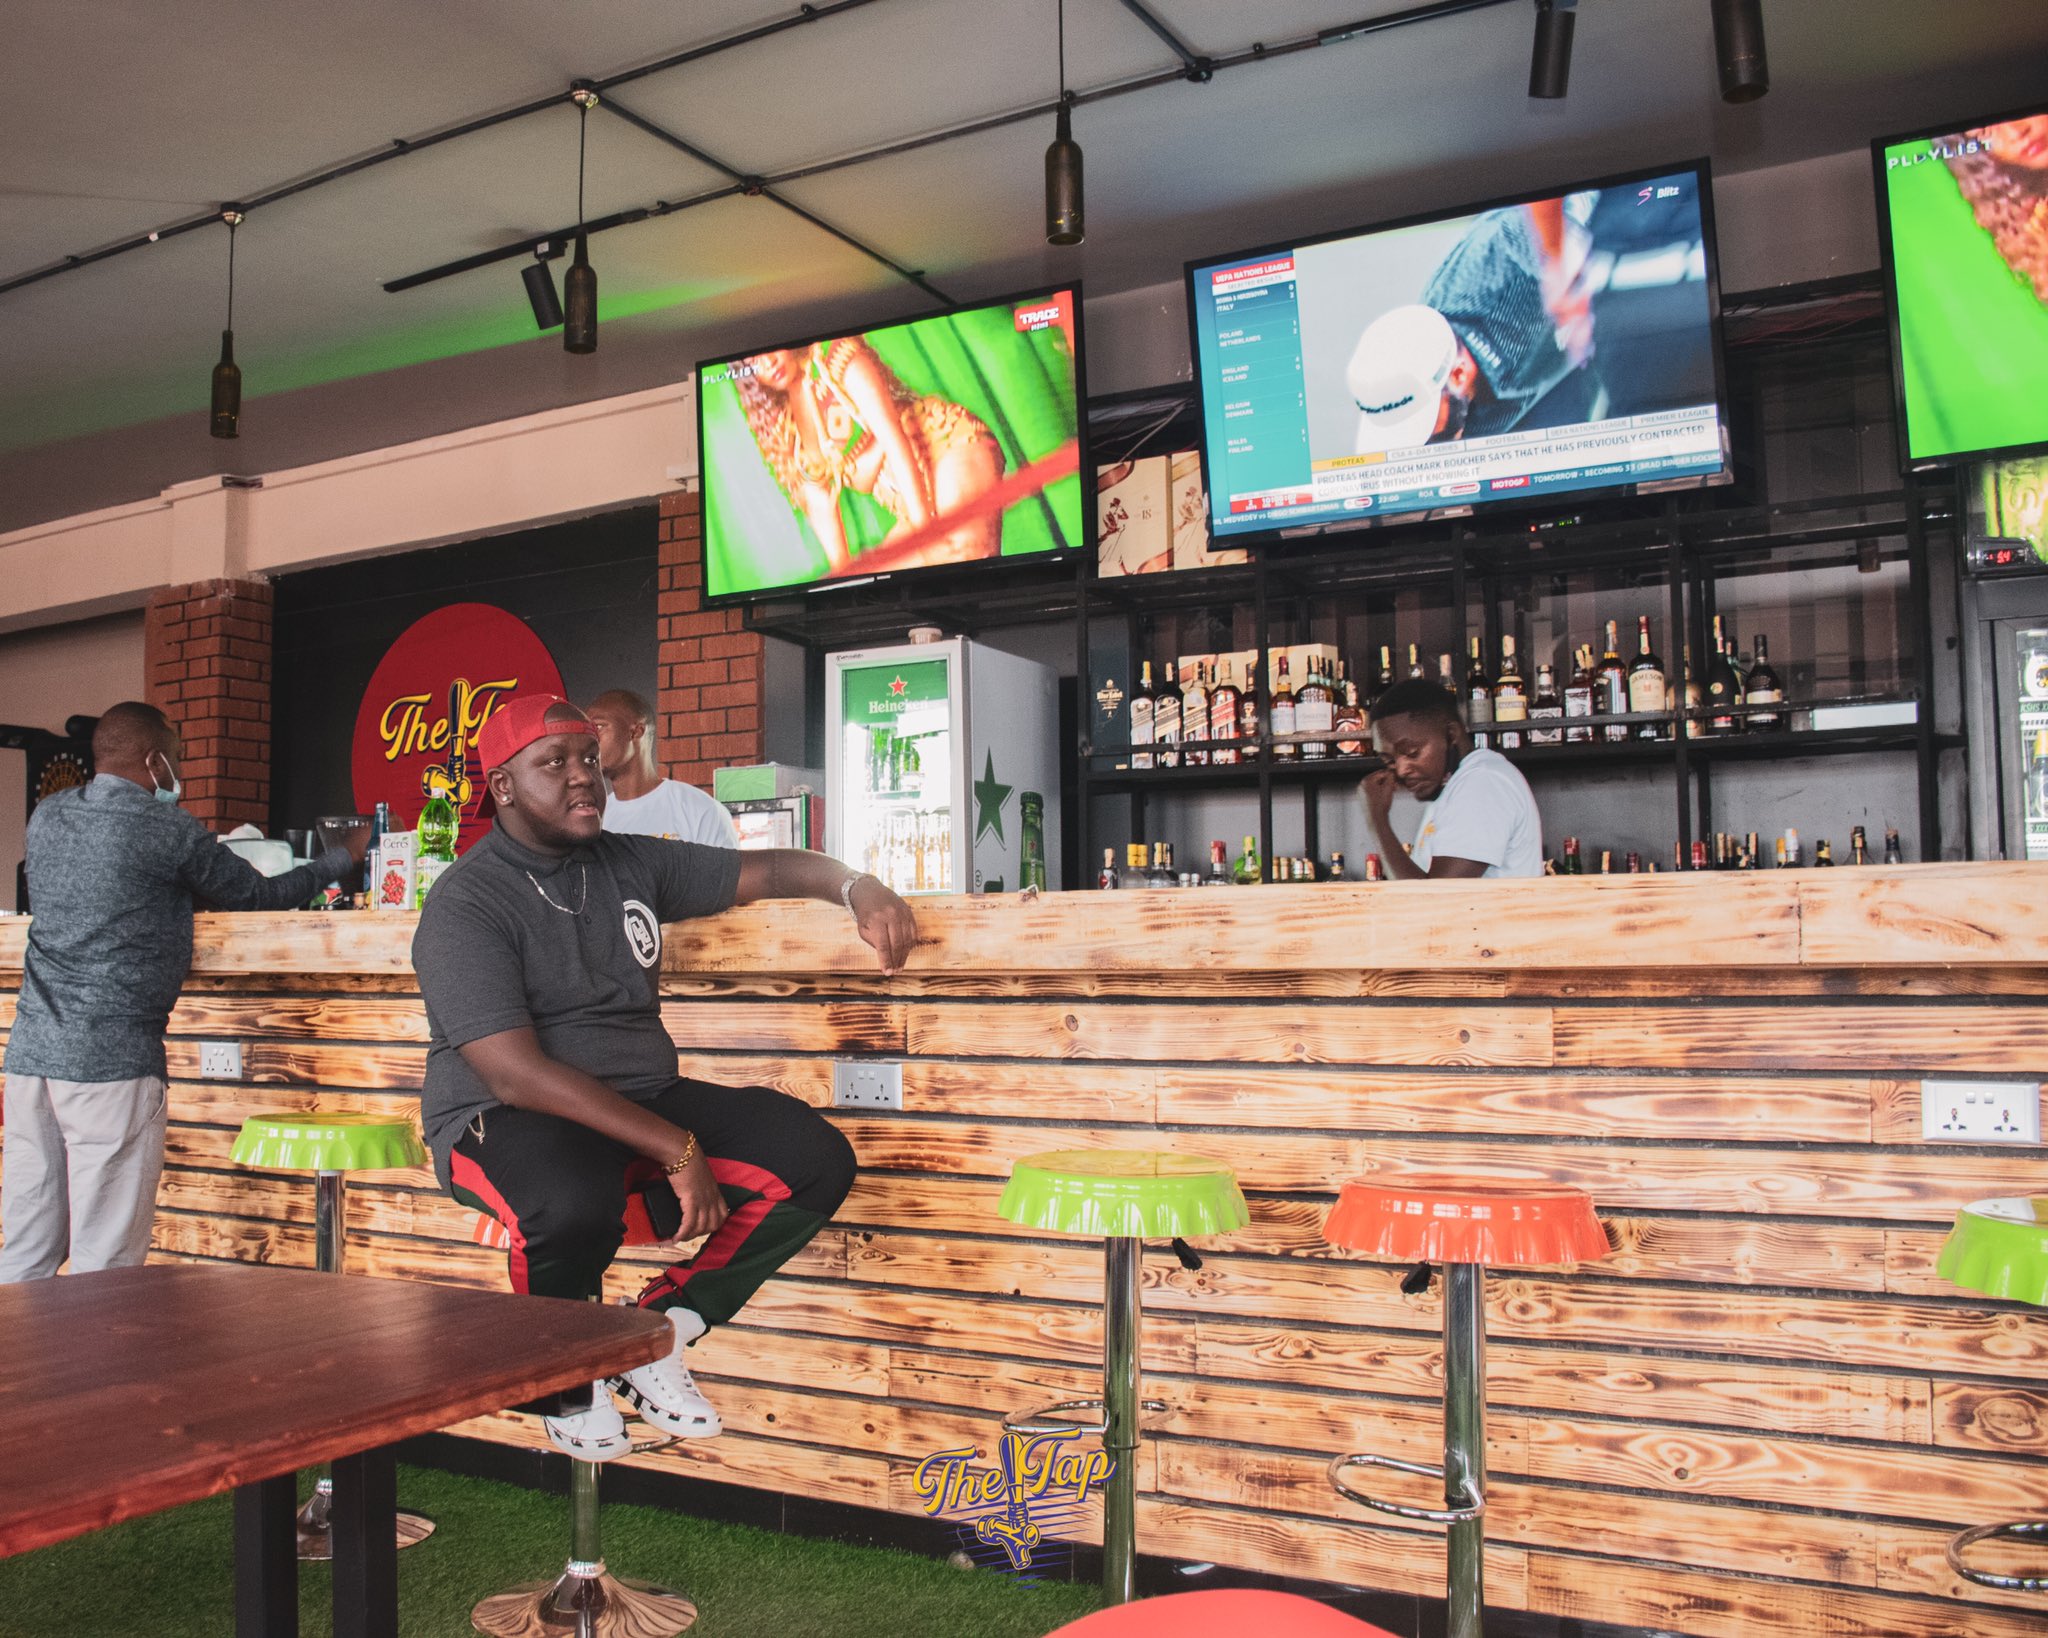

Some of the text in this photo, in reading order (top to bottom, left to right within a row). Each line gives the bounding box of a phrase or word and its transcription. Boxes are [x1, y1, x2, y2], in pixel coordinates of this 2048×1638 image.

[1656, 186, 1680, 199] Blitz
[1215, 261, 1291, 283] UEFA NATIONS LEAGUE
[1019, 306, 1060, 325] TRACE
[1216, 303, 1235, 313] ITALY
[1640, 408, 1710, 424] PREMIER LEAGUE
[1550, 419, 1628, 437] UEFA NATIONS LEAGUE
[1485, 433, 1526, 446] FOOTBALL
[1317, 425, 1705, 485] PROTEAS HEAD COACH MARK BOUCHER SAYS THAT HE HAS PREVIOUSLY CONTRACTED
[1391, 444, 1458, 459] CSA 4-DAY SERIES
[1331, 457, 1365, 468] PROTEAS
[1318, 466, 1480, 497] CORONAVIRUS WITHOUT KNOWING IT
[1491, 478, 1525, 490] MOTOGP
[1533, 471, 1578, 484] TOMORROW
[1584, 465, 1625, 478] BECOMING
[1223, 514, 1258, 525] MEDVEDEV
[1631, 673, 1664, 685] JAMESON
[868, 698, 929, 714] Heineken
[380, 693, 450, 762] The
[383, 837, 409, 850] Ceres
